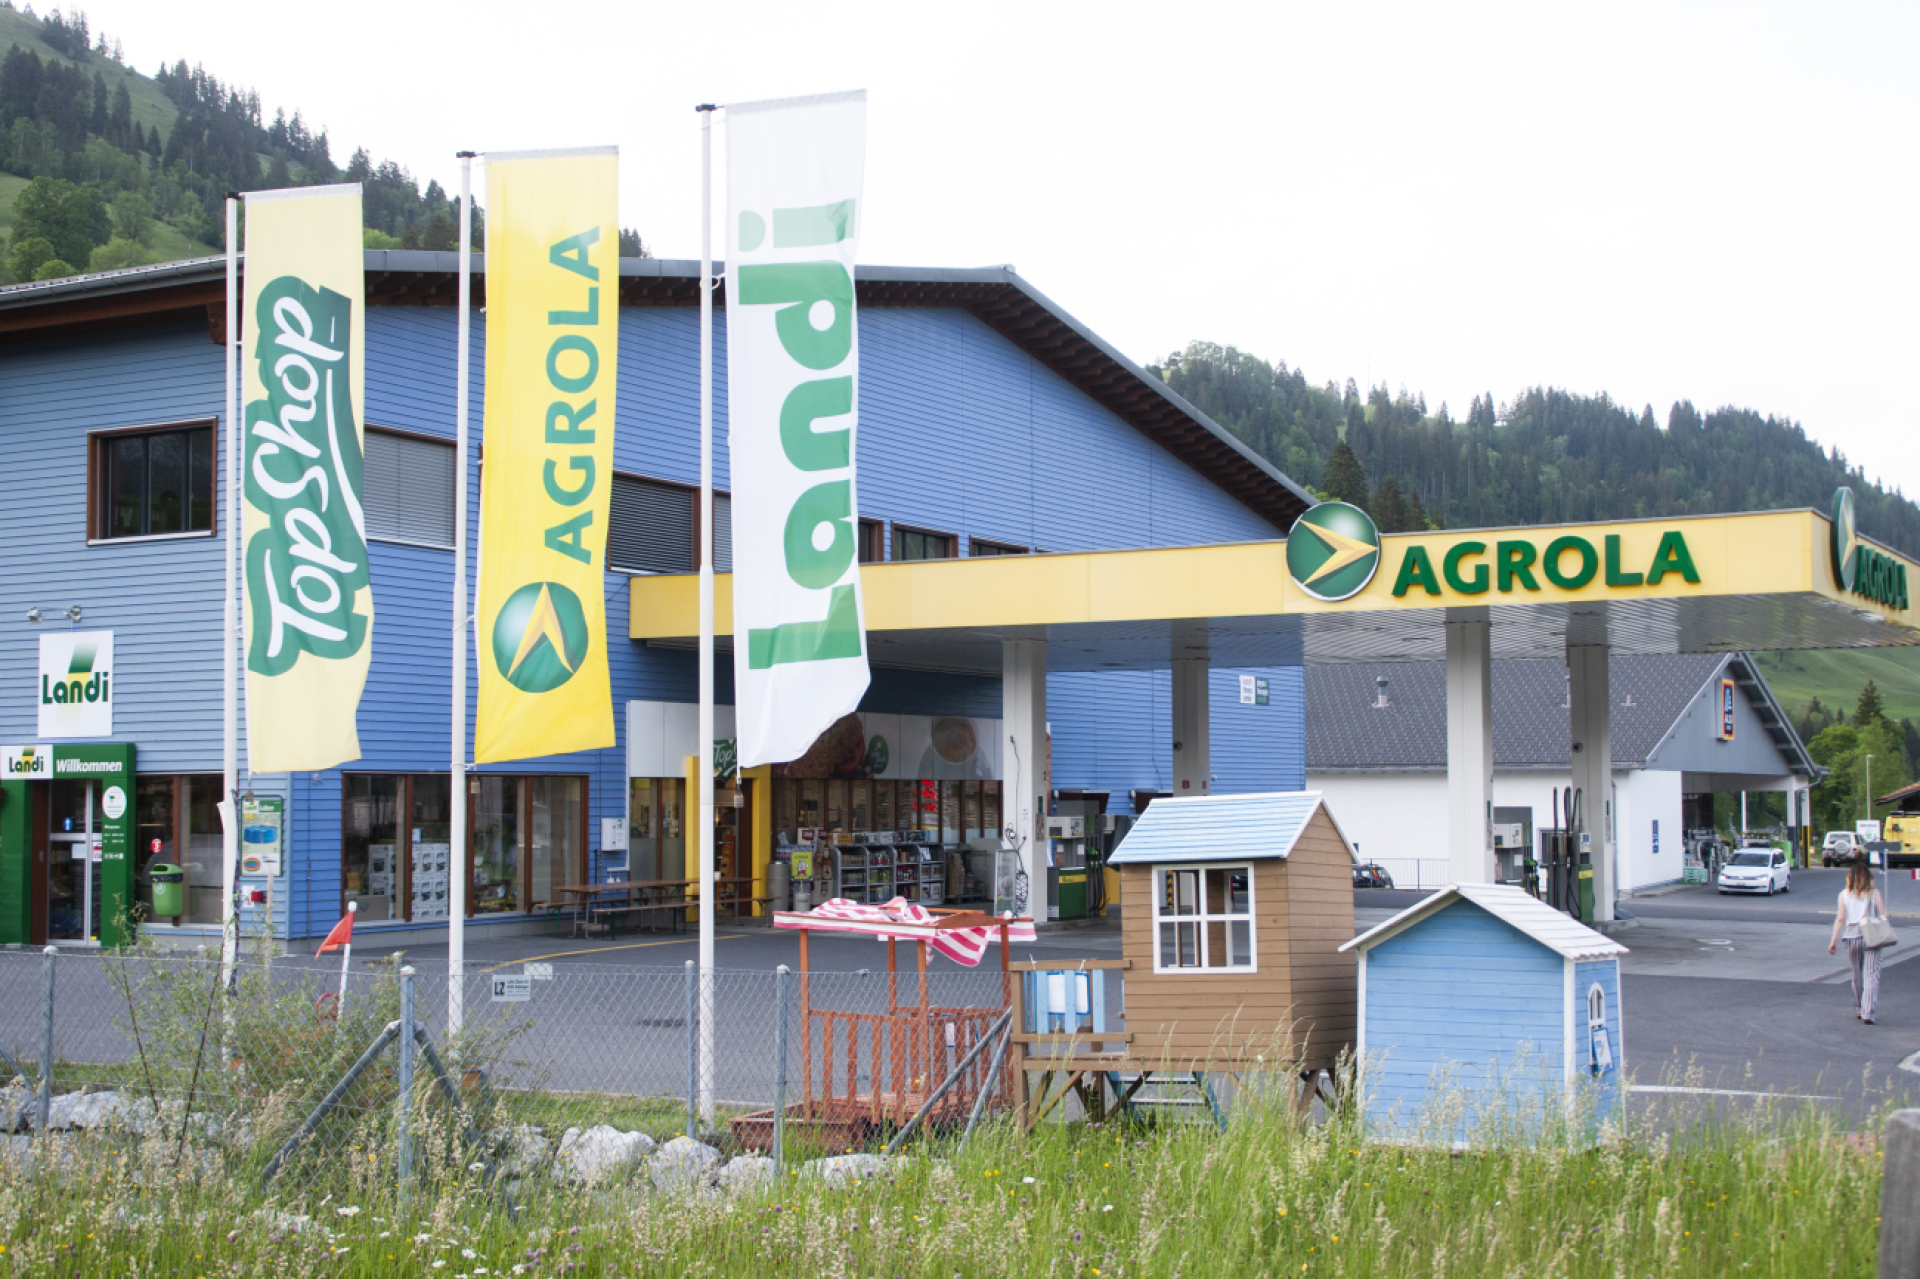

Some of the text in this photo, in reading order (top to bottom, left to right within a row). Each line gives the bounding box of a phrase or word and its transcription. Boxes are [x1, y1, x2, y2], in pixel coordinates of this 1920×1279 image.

[542, 226, 600, 565] AGROLA
[737, 199, 862, 669] Landi
[1391, 531, 1701, 597] AGROLA
[1853, 545, 1909, 611] AGROLA
[42, 671, 109, 704] Landi
[8, 755, 122, 773] Landi Willkommen
